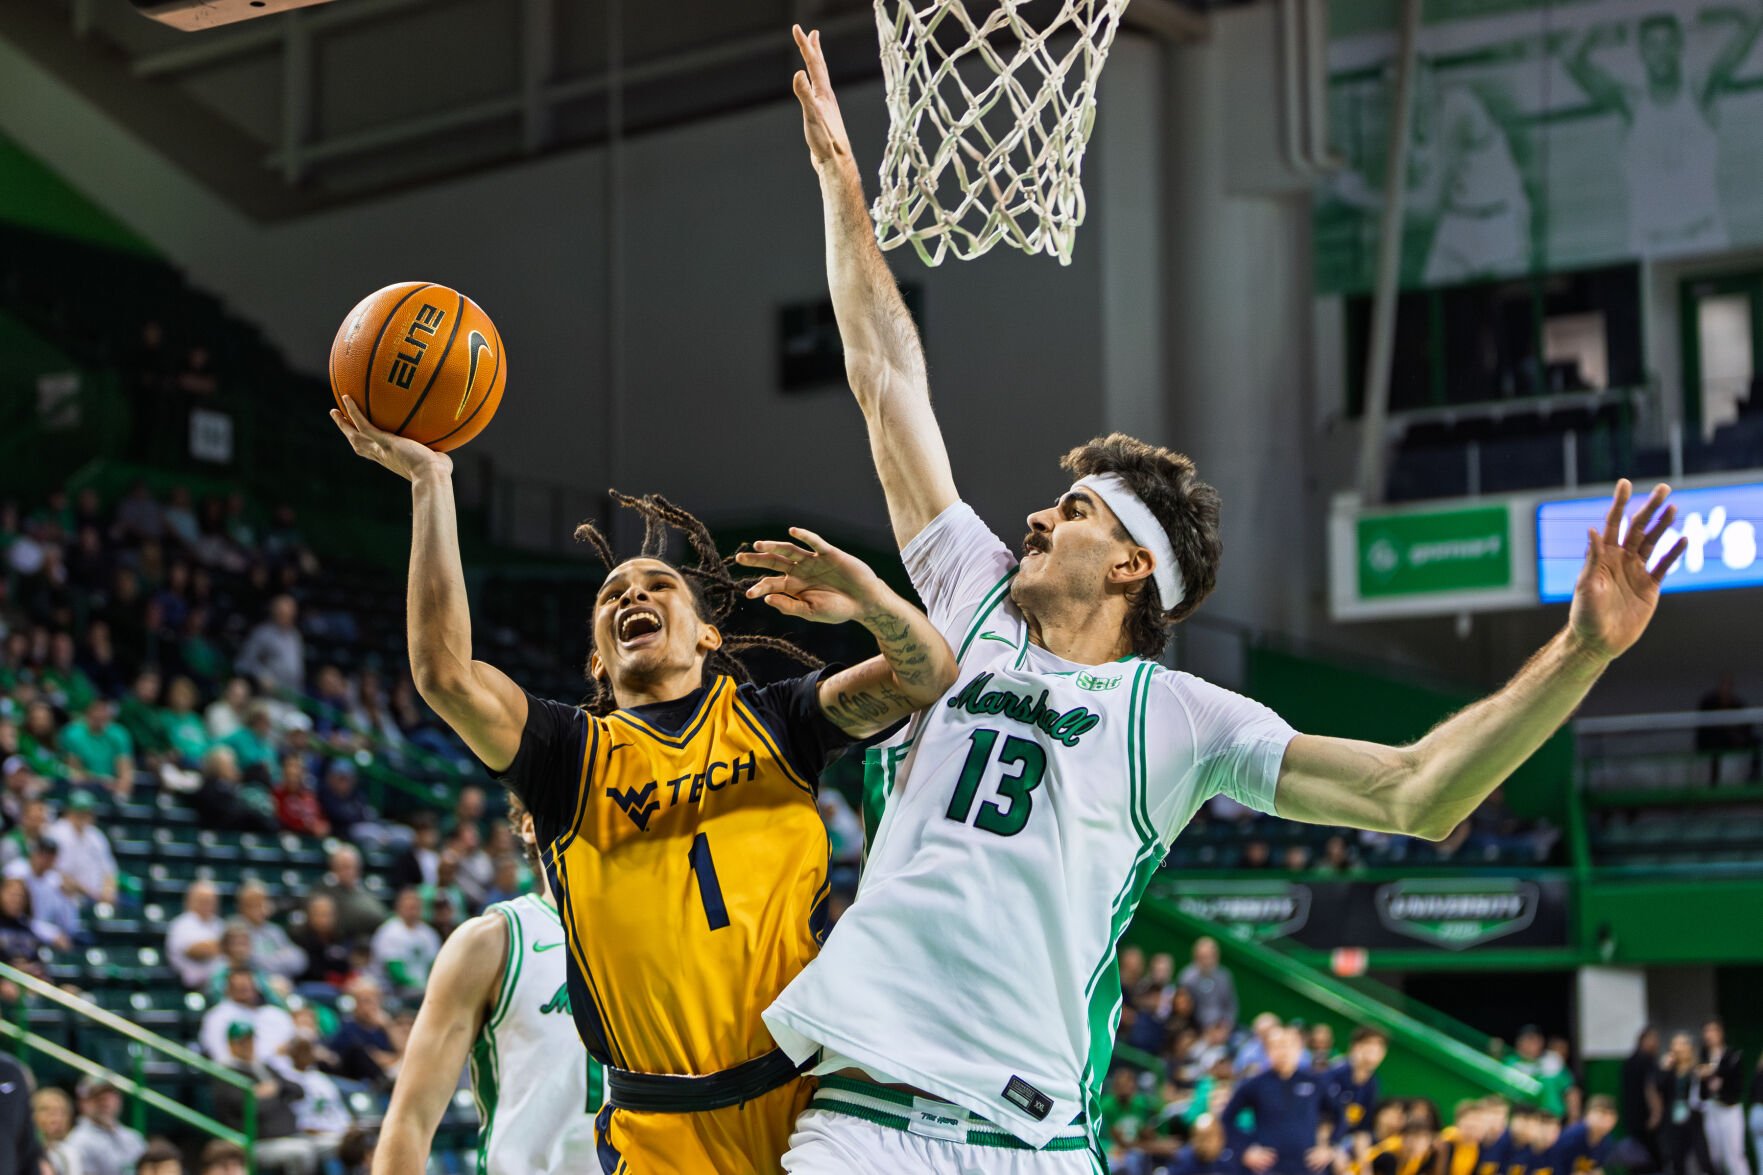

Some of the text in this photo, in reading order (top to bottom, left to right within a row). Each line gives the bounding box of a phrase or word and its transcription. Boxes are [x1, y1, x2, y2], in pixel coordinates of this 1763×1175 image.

[387, 303, 446, 390] ELITE
[947, 671, 1100, 747] Marshall
[666, 750, 756, 807] TECH
[945, 728, 1047, 837] 13
[688, 831, 731, 931] 1
